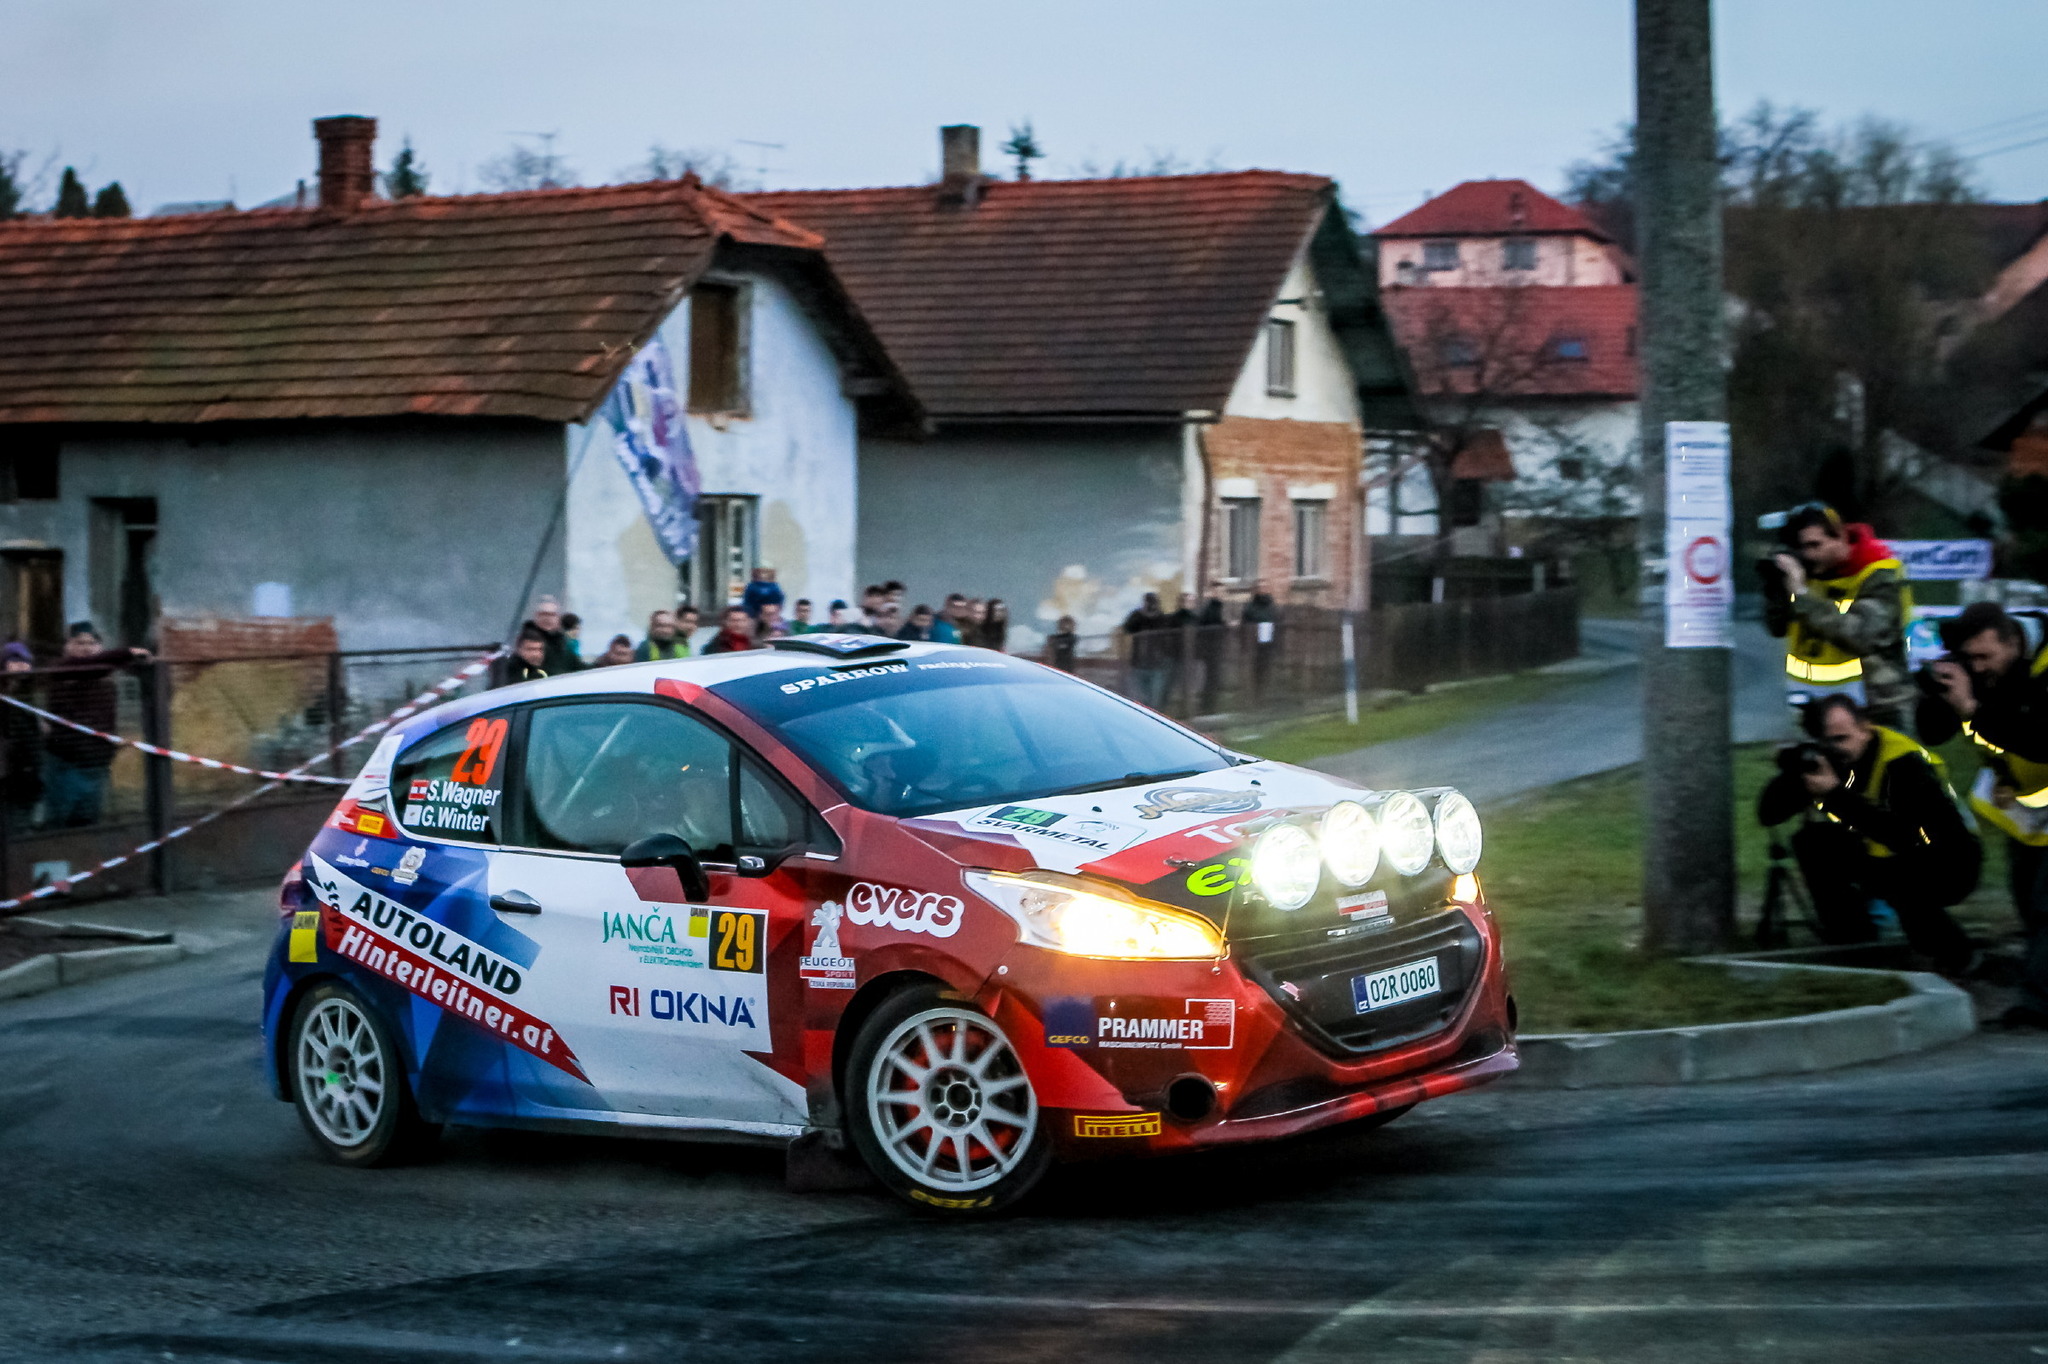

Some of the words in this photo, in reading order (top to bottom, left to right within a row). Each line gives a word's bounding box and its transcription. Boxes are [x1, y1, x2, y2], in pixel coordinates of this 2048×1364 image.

[780, 663, 910, 695] SPARROW
[450, 718, 508, 785] 29
[427, 779, 502, 810] S.Wagner
[421, 805, 490, 832] G.Winter
[1001, 807, 1056, 825] 29
[976, 819, 1109, 850] SVARMETAL
[848, 882, 962, 932] evers
[602, 906, 677, 944] JANČA
[716, 911, 755, 971] 29
[350, 892, 522, 995] AUTOLAND
[800, 957, 854, 968] PEUGEOT
[338, 925, 554, 1055] Hinterleitner.at
[1369, 974, 1400, 1003] 02R
[1400, 965, 1435, 994] 0080
[609, 985, 640, 1017] RI
[650, 989, 756, 1028] OKNA
[1048, 1035, 1090, 1045] GEFCO
[1098, 1017, 1204, 1040] PRAMMER
[1075, 1114, 1160, 1137] PIRELLI
